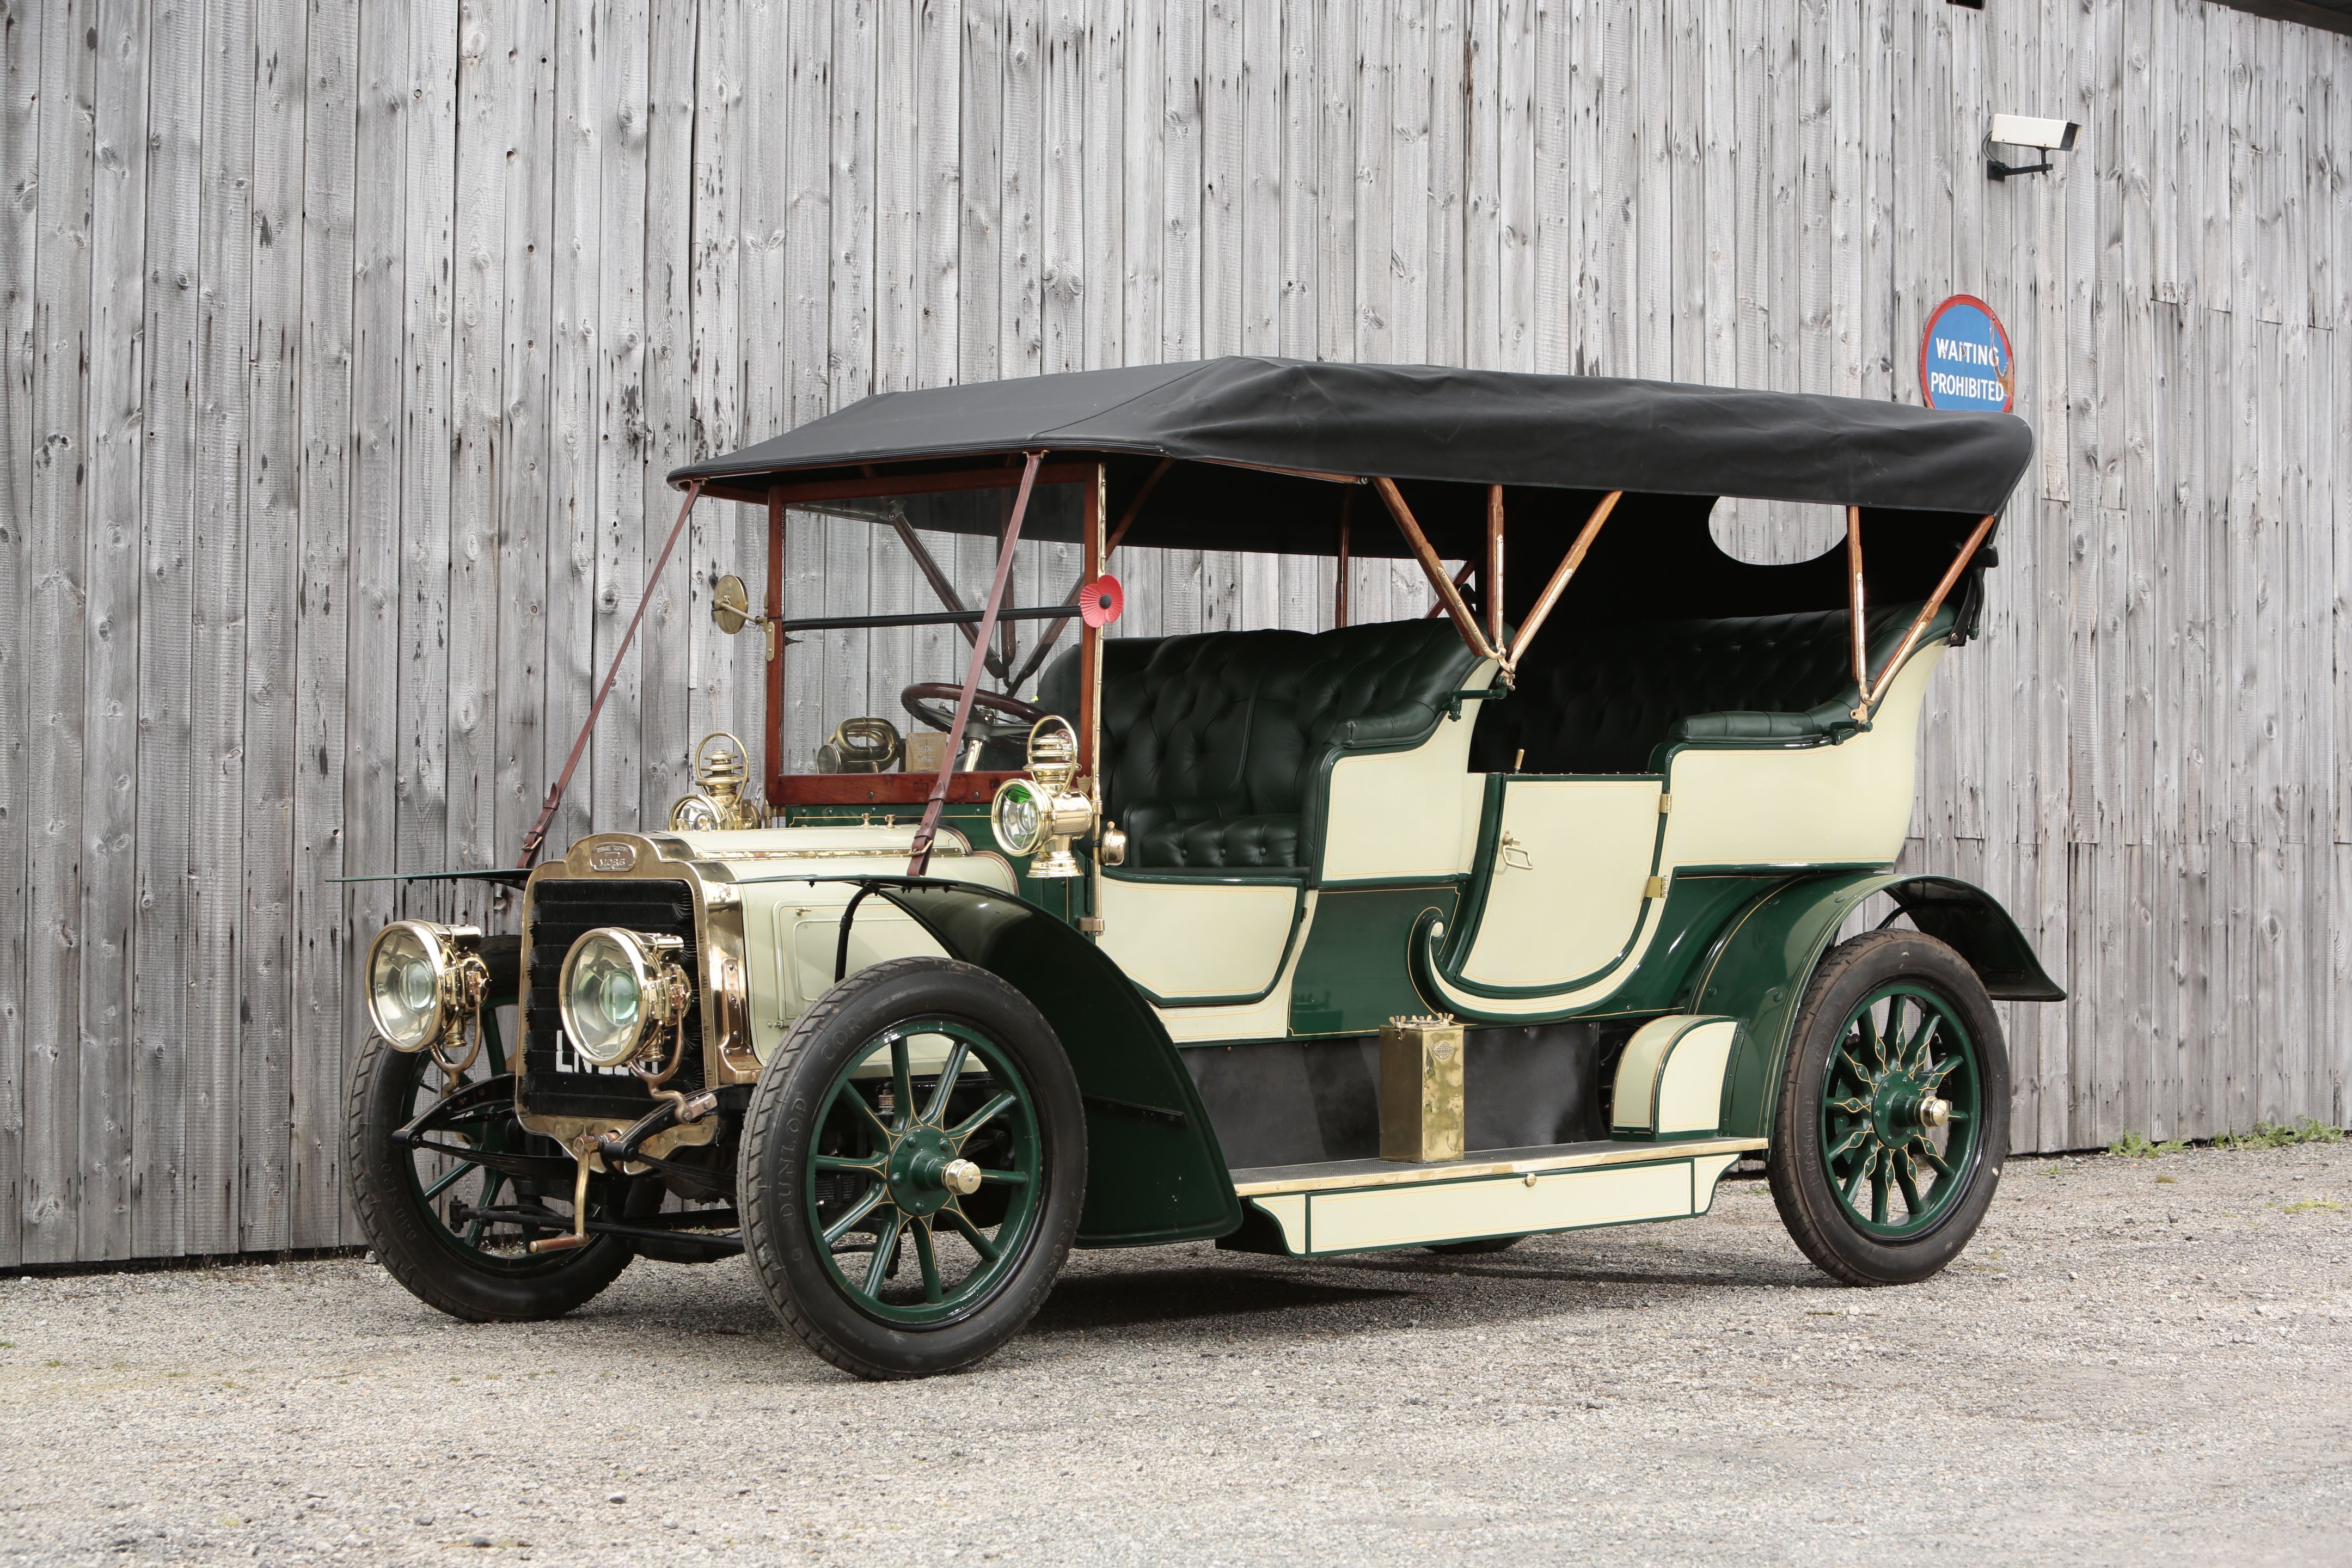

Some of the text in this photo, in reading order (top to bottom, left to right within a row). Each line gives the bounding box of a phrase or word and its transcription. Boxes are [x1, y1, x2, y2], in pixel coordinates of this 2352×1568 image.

[1935, 337, 1999, 366] WAITING
[1931, 372, 2004, 402] PROHIBITED
[599, 858, 625, 866] MORS
[779, 1006, 871, 1222] DUNLOP CORD
[1803, 1094, 1821, 1190] DUNLOP
